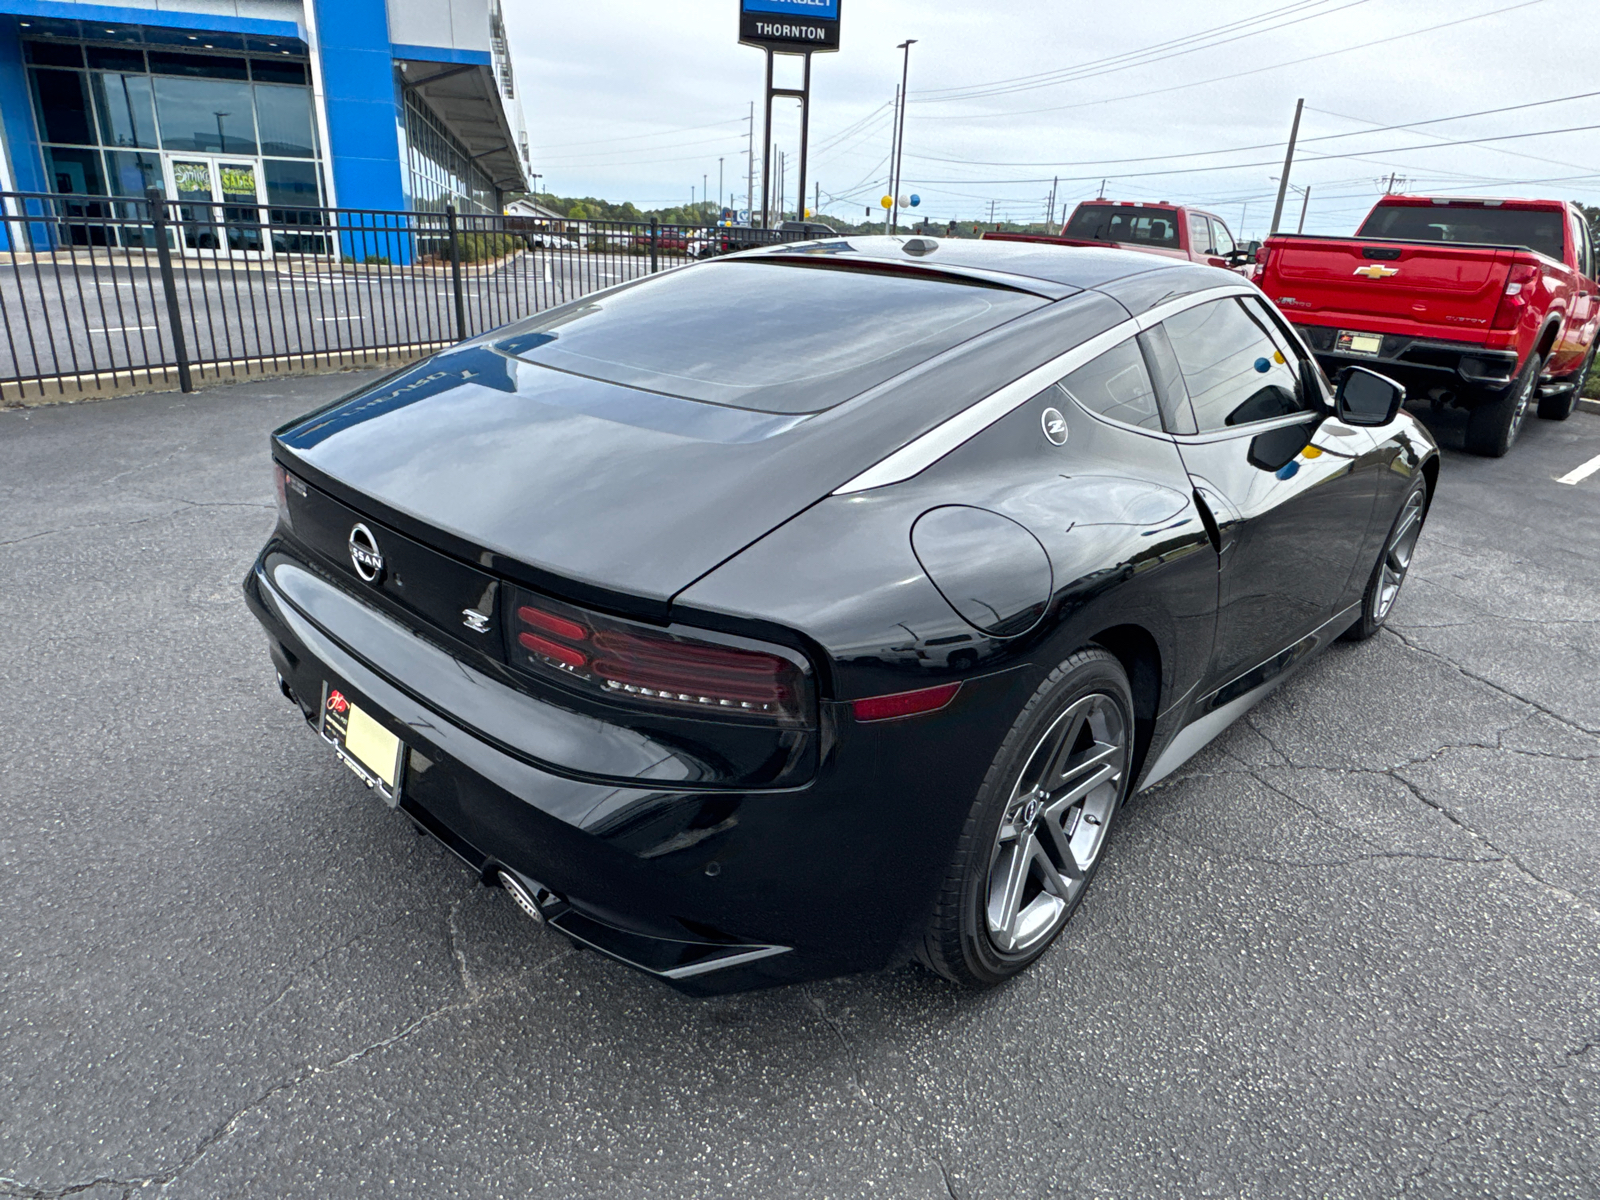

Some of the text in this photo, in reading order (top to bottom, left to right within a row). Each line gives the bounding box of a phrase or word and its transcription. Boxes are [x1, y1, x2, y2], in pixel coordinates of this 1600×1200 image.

[756, 22, 825, 39] THORNTON
[221, 174, 255, 189] SALES
[350, 545, 382, 569] SSAN
